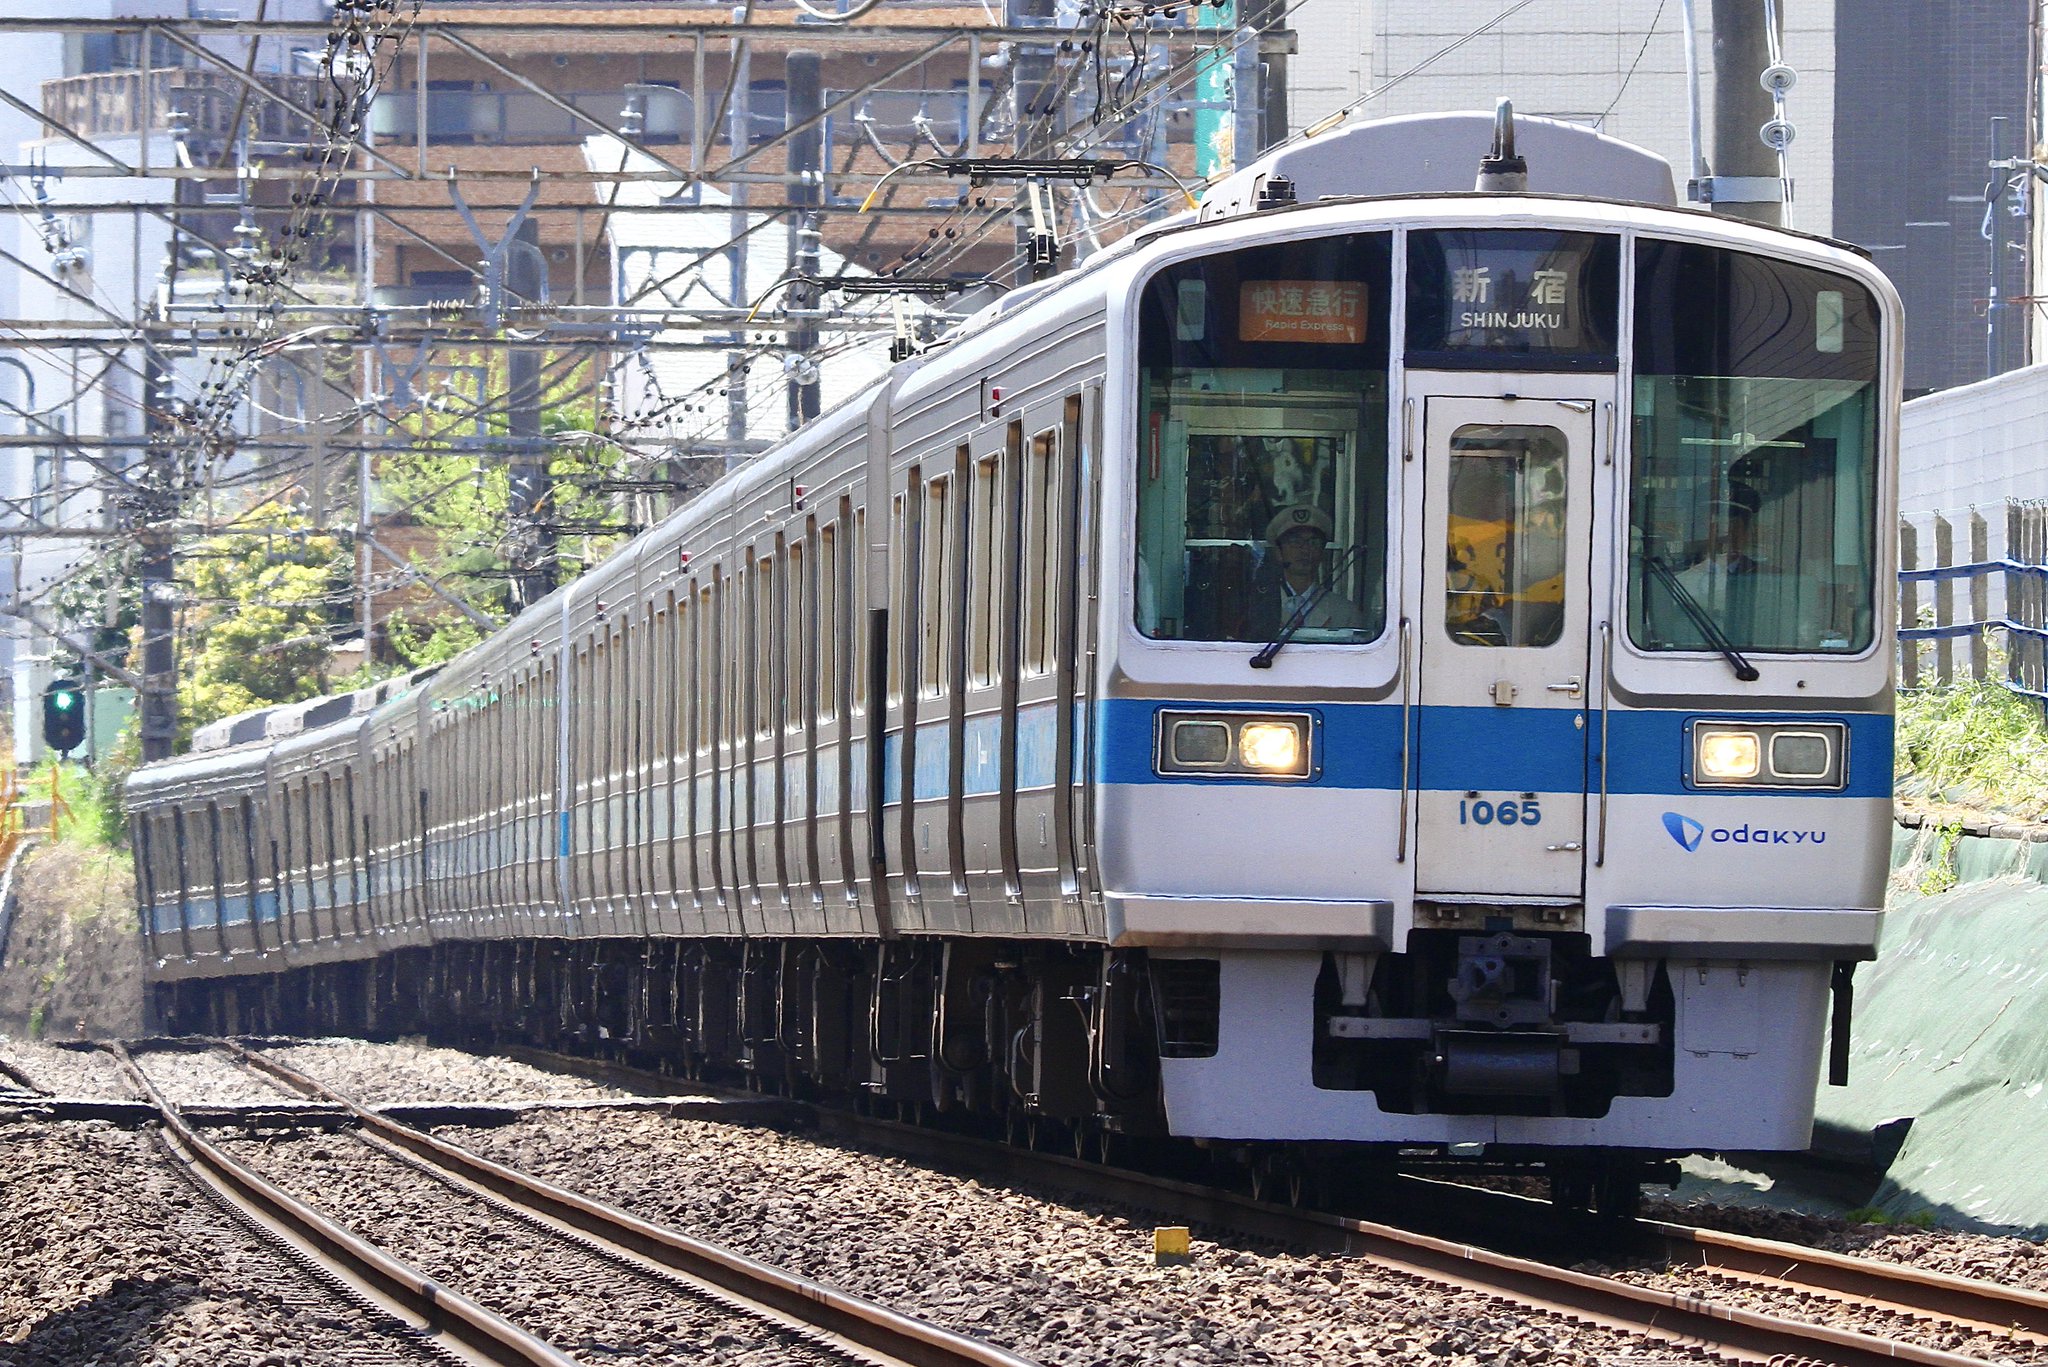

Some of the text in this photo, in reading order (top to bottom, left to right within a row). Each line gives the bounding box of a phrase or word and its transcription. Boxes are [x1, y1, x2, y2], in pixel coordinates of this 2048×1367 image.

[1252, 286, 1360, 318] 快速急行
[1265, 319, 1345, 332] Rapid Express
[1460, 311, 1561, 329] SHINJUKU
[1459, 800, 1541, 826] 1065
